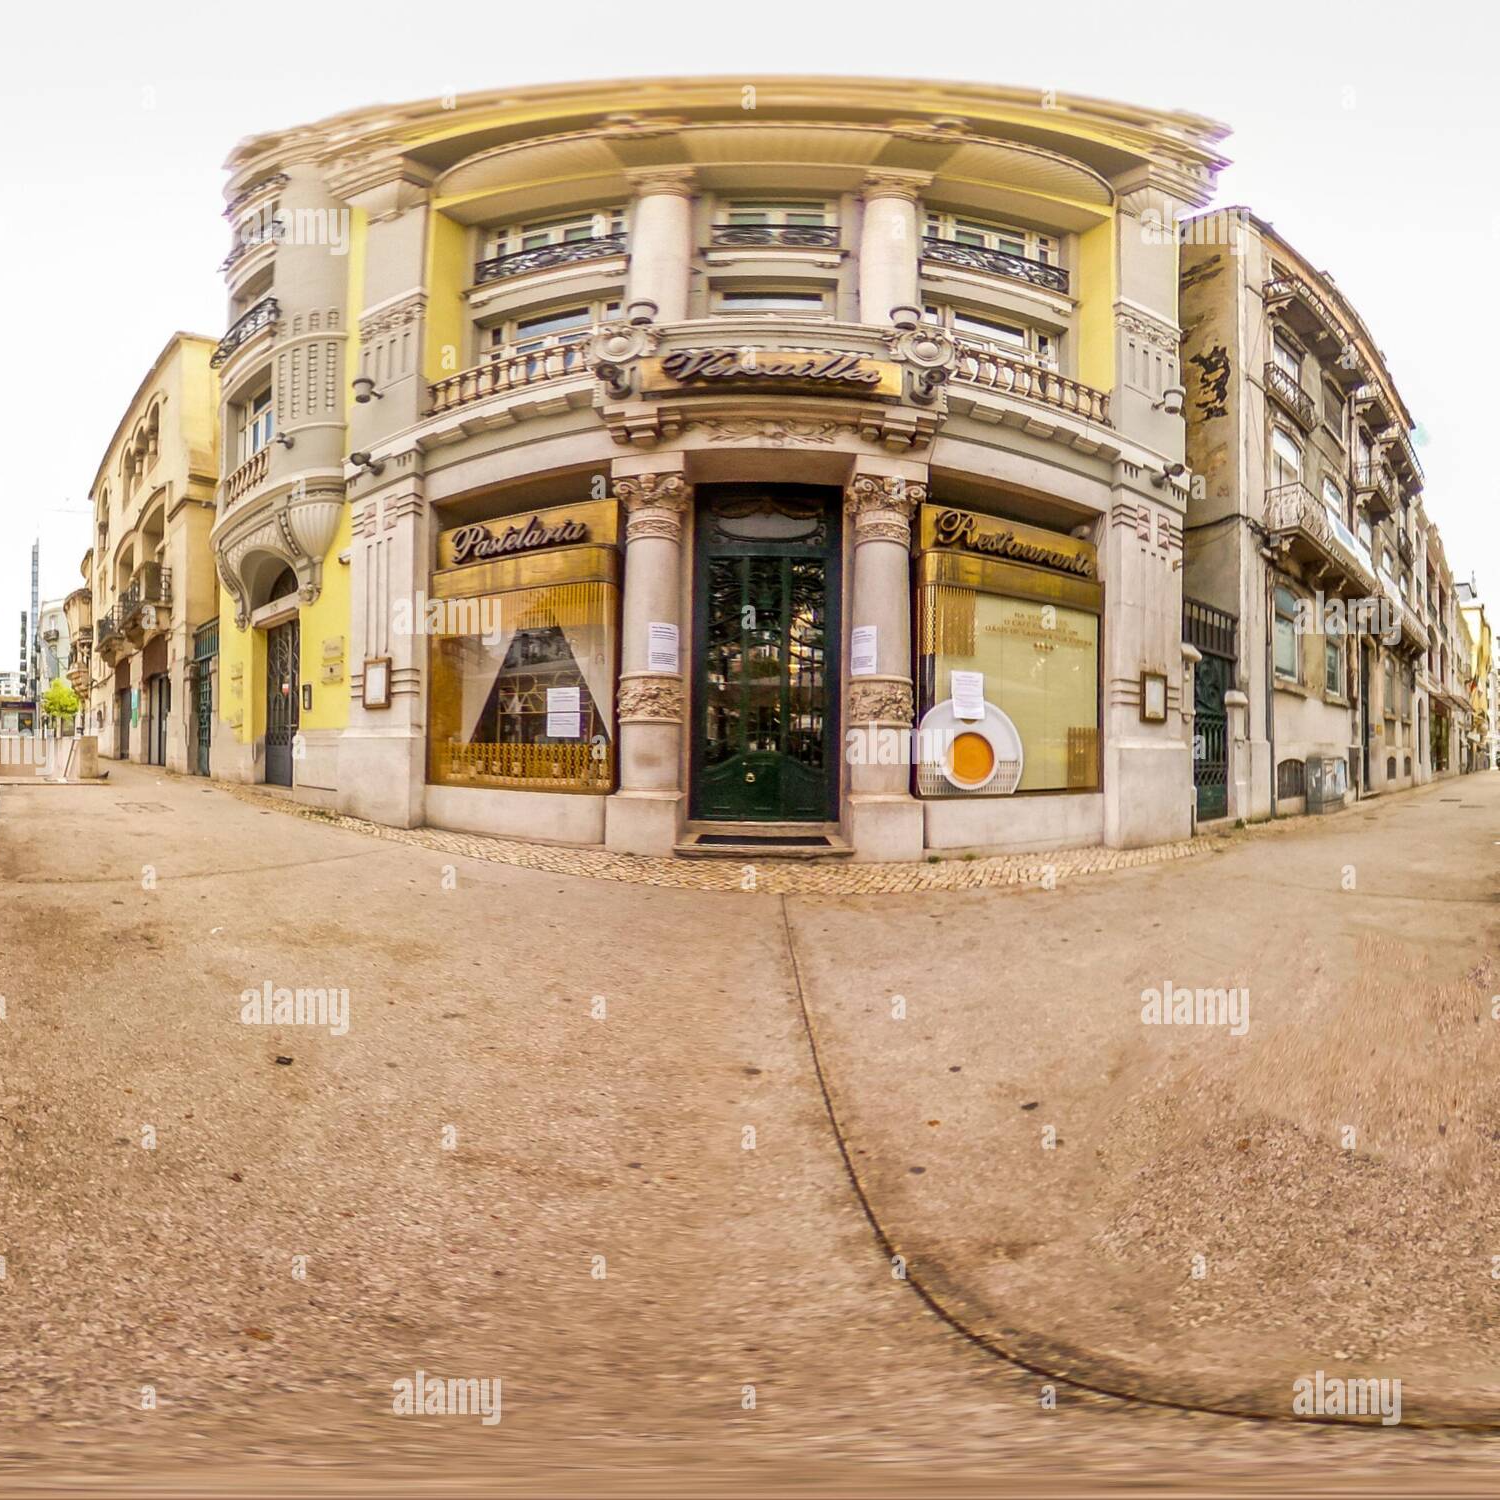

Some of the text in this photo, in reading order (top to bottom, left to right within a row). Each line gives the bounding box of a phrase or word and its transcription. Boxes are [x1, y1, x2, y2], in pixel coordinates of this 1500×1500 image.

[661, 349, 882, 384] Versailles
[452, 515, 588, 565] Pastelaria
[935, 510, 1093, 575] Restaurante
